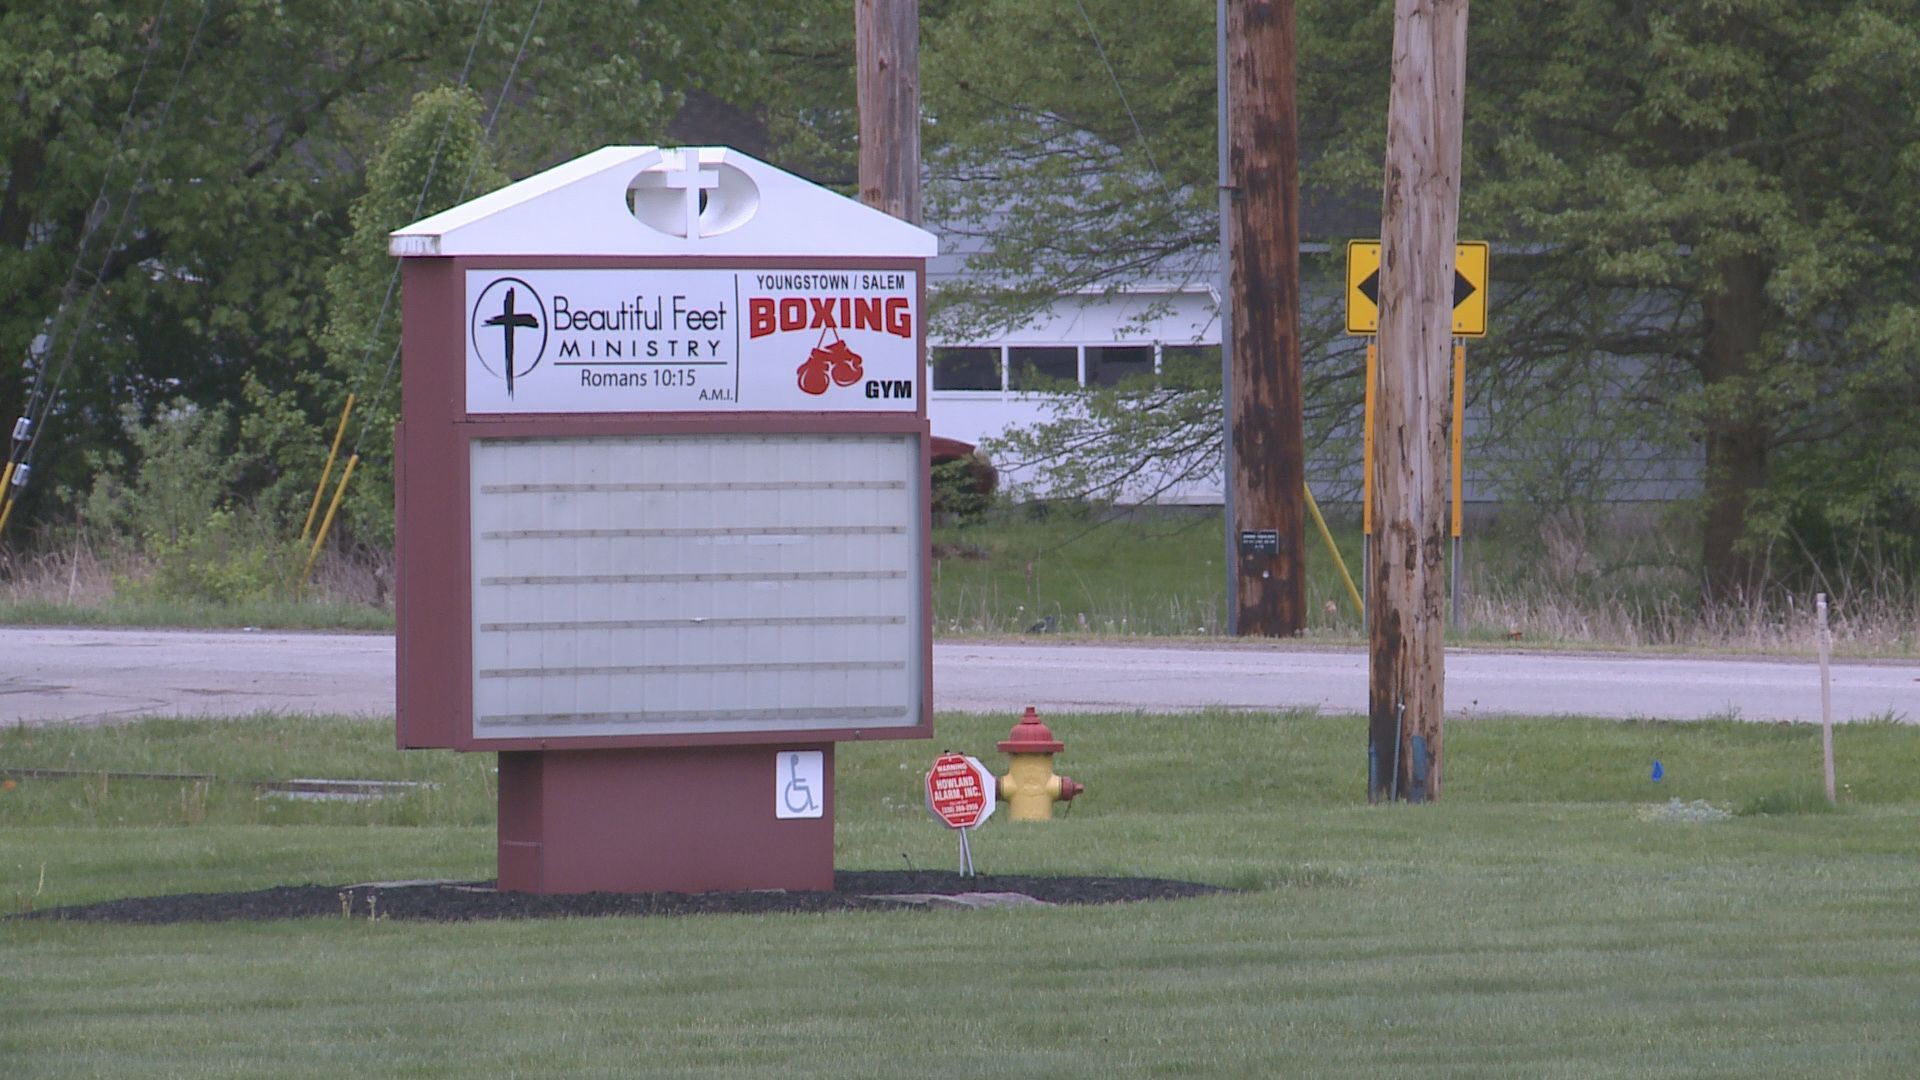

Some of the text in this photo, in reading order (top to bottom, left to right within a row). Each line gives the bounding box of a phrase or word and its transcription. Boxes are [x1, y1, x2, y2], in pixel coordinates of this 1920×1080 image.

[757, 274, 849, 290] YOUNGSTOWN
[862, 274, 905, 290] SALEM
[554, 295, 727, 331] Beautiful Feet
[749, 297, 912, 339] BOXING
[559, 340, 721, 358] MINISTRY
[580, 368, 696, 388] Romans 10:15
[698, 389, 734, 401] A.M.I.
[865, 380, 912, 399] GYM
[937, 763, 967, 773] WARNING
[936, 776, 974, 790] HOWLAND
[934, 786, 982, 801] ALARM, INC.
